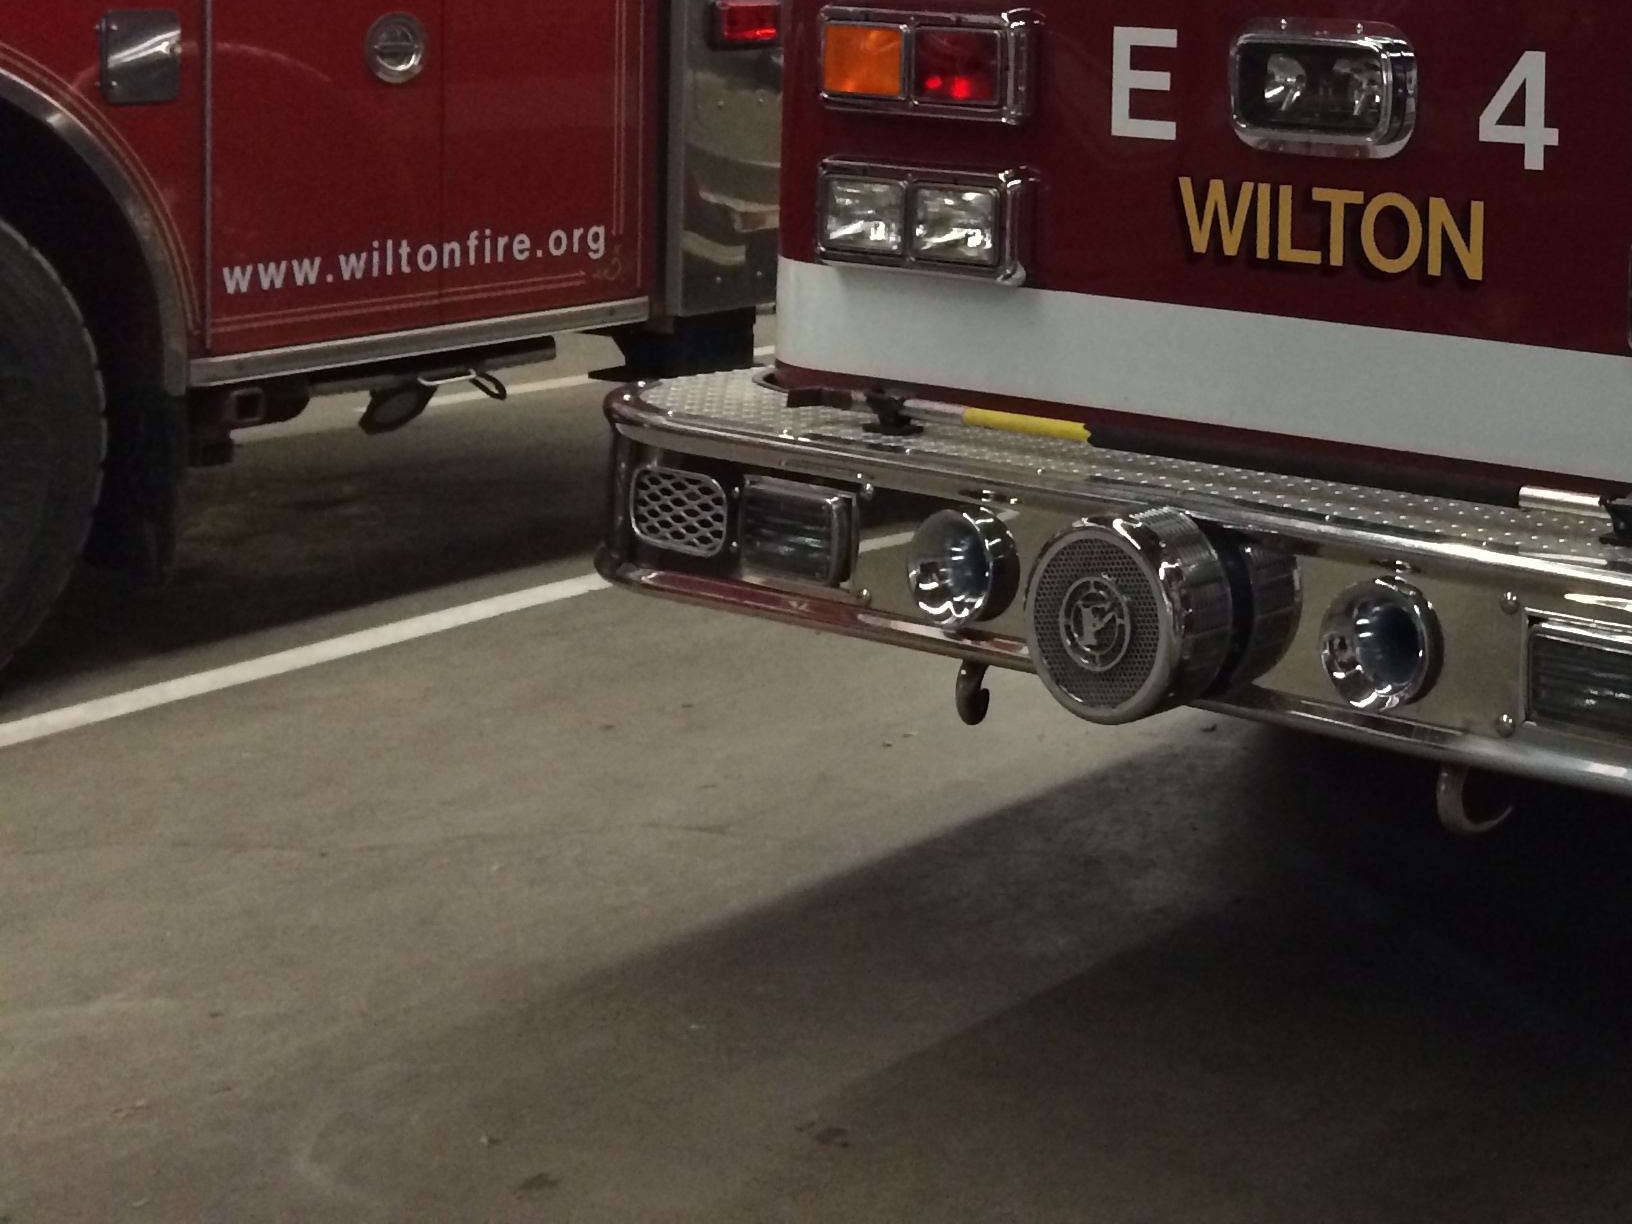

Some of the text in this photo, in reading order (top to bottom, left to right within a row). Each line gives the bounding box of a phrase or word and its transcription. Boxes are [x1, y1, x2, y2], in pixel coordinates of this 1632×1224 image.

[1111, 25, 1559, 171] E 4
[221, 224, 606, 295] www.wiltonfire.org
[1177, 176, 1485, 281] WILTON
